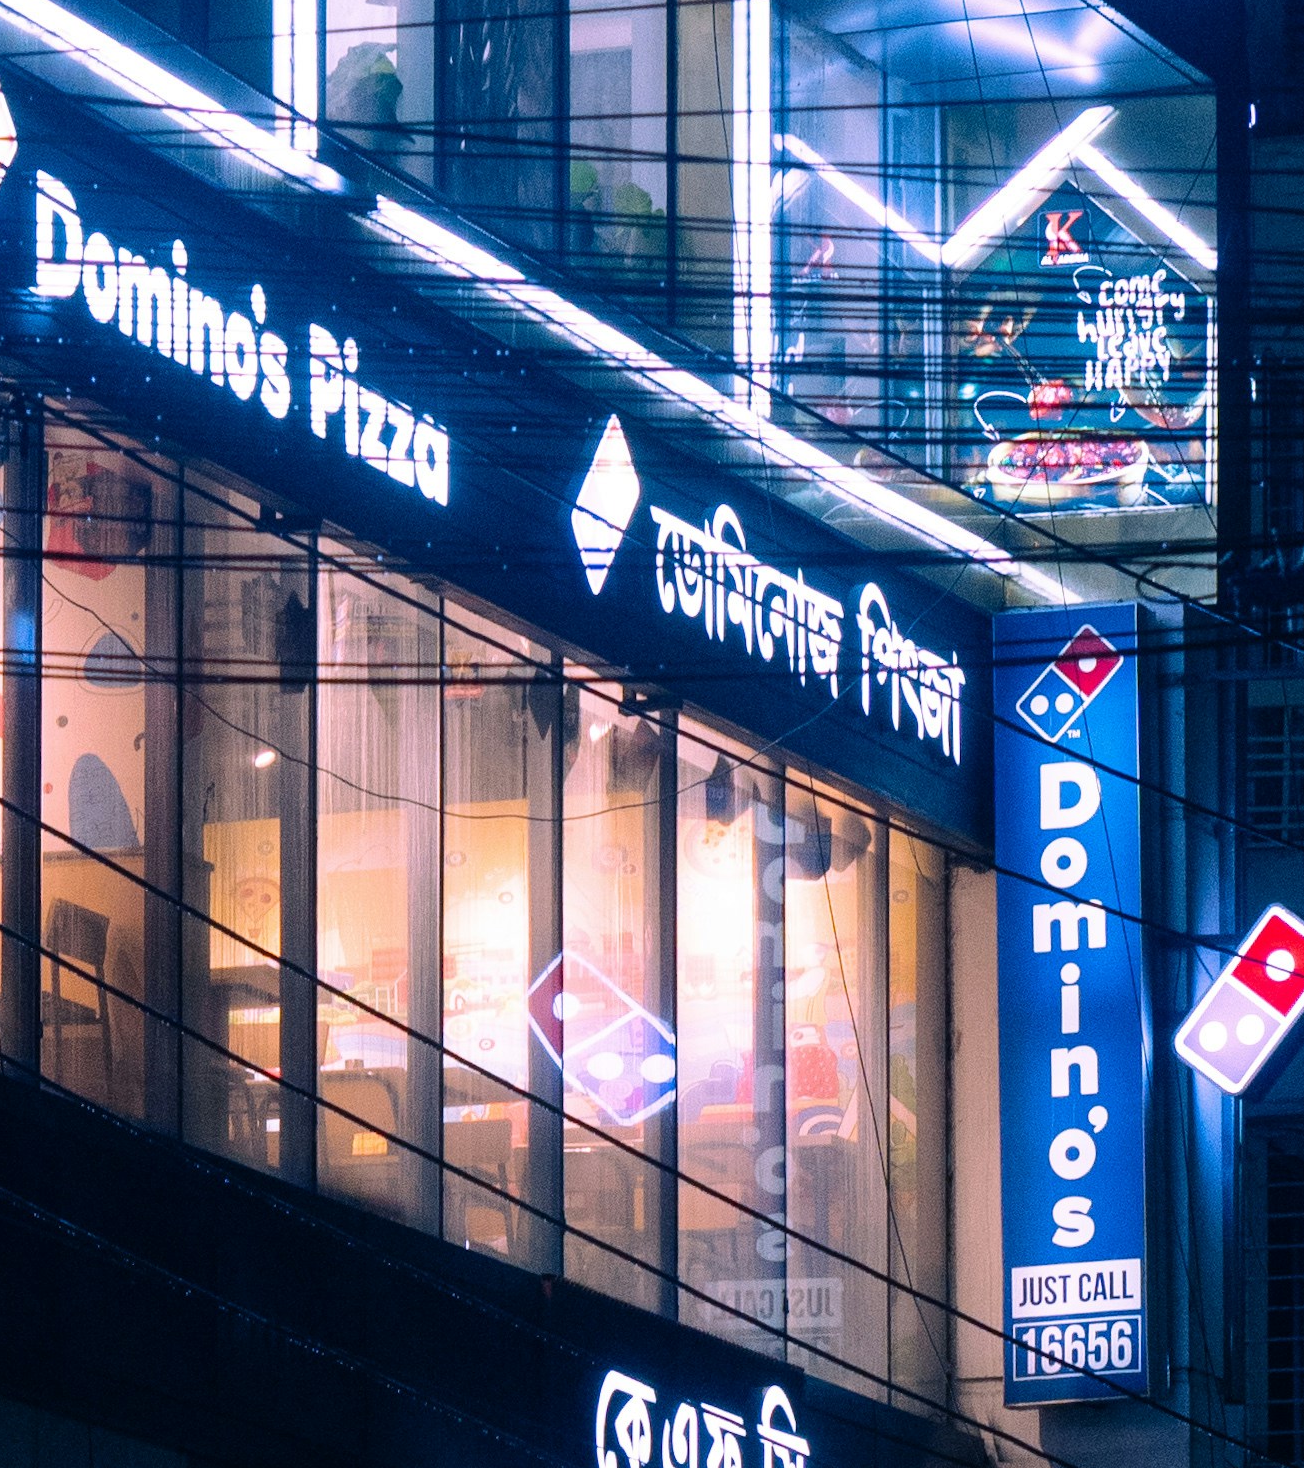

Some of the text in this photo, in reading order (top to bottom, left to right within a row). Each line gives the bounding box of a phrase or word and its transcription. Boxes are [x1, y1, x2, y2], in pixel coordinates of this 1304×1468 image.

[28, 168, 450, 508] Domino's Pizza
[1032, 761, 1107, 1248] Domino's
[1019, 1268, 1136, 1307] JUST CALL
[1021, 1323, 1134, 1373] 16656
